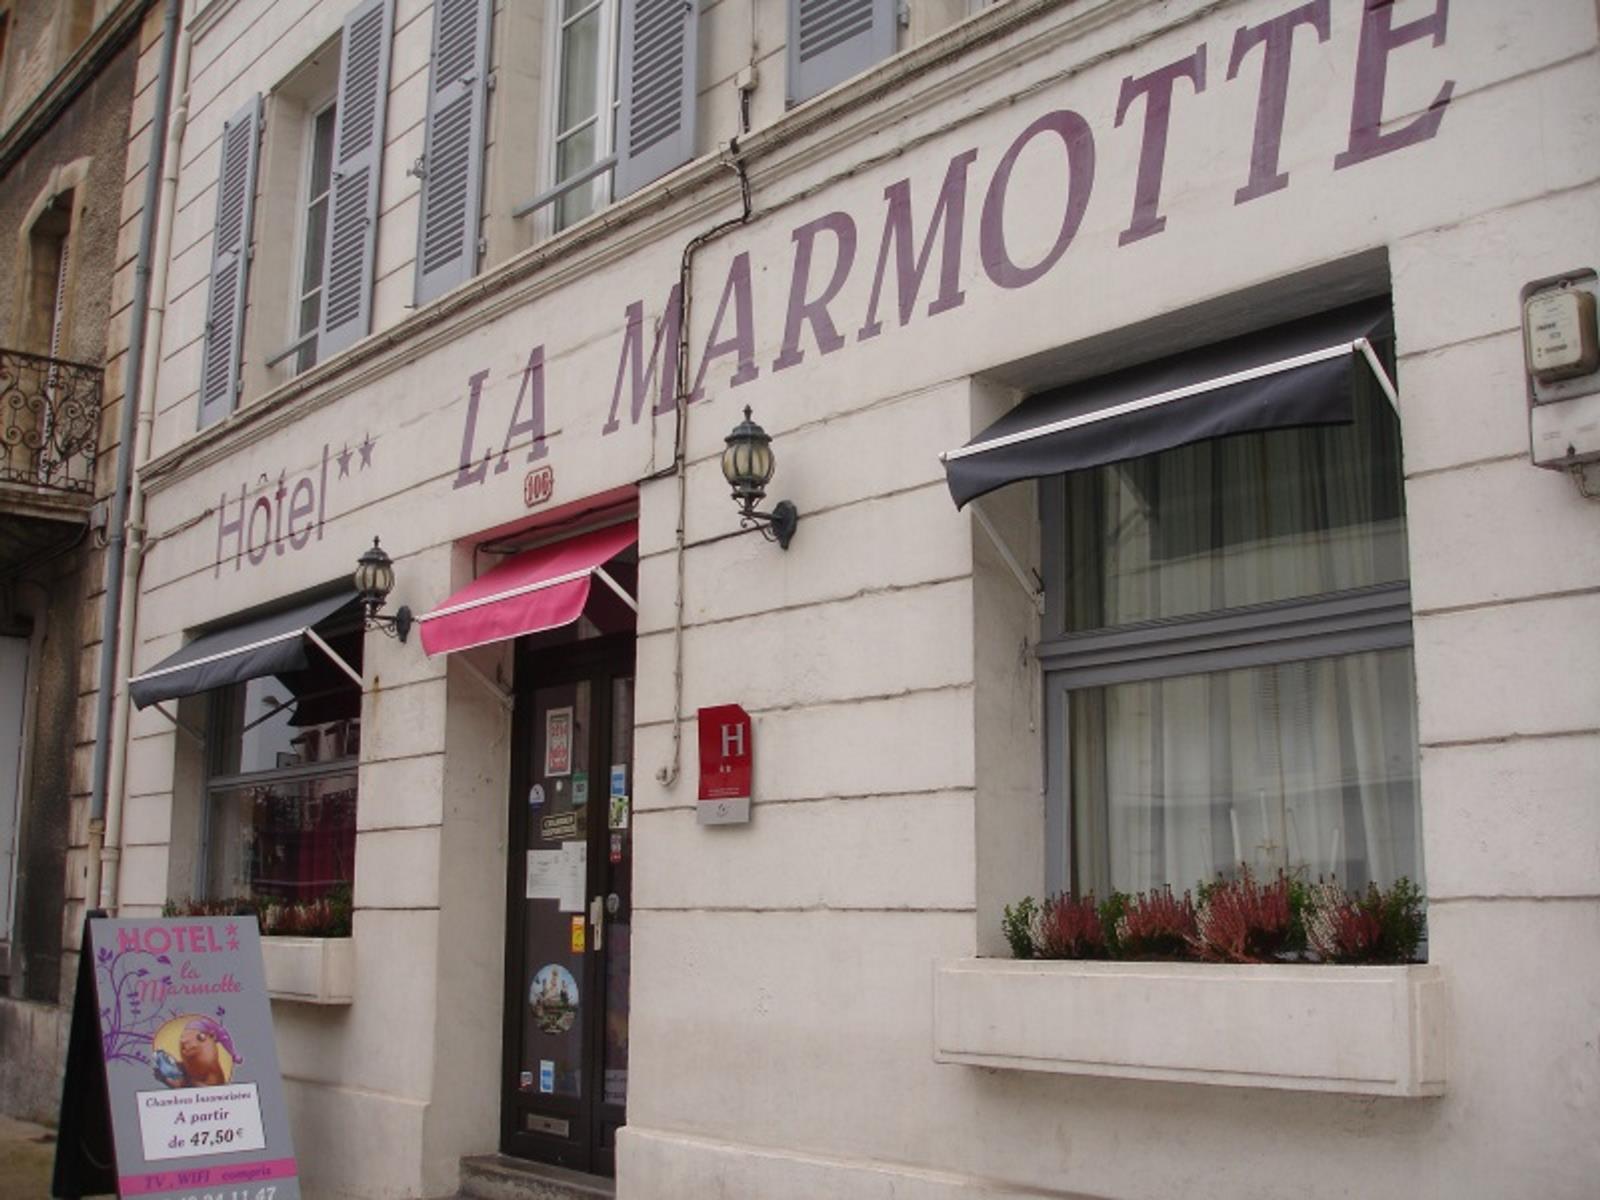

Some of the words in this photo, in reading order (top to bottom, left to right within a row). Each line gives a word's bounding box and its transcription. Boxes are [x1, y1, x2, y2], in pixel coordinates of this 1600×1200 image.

[453, 344, 550, 490] LA
[602, 0, 1456, 436] MARMOTTE
[214, 443, 329, 579] Hôtel
[722, 723, 744, 757] H
[117, 926, 223, 954] HOTEL
[181, 960, 201, 979] la
[137, 973, 241, 1004] Marmotte
[190, 1107, 230, 1124] partir
[168, 1136, 185, 1149] de
